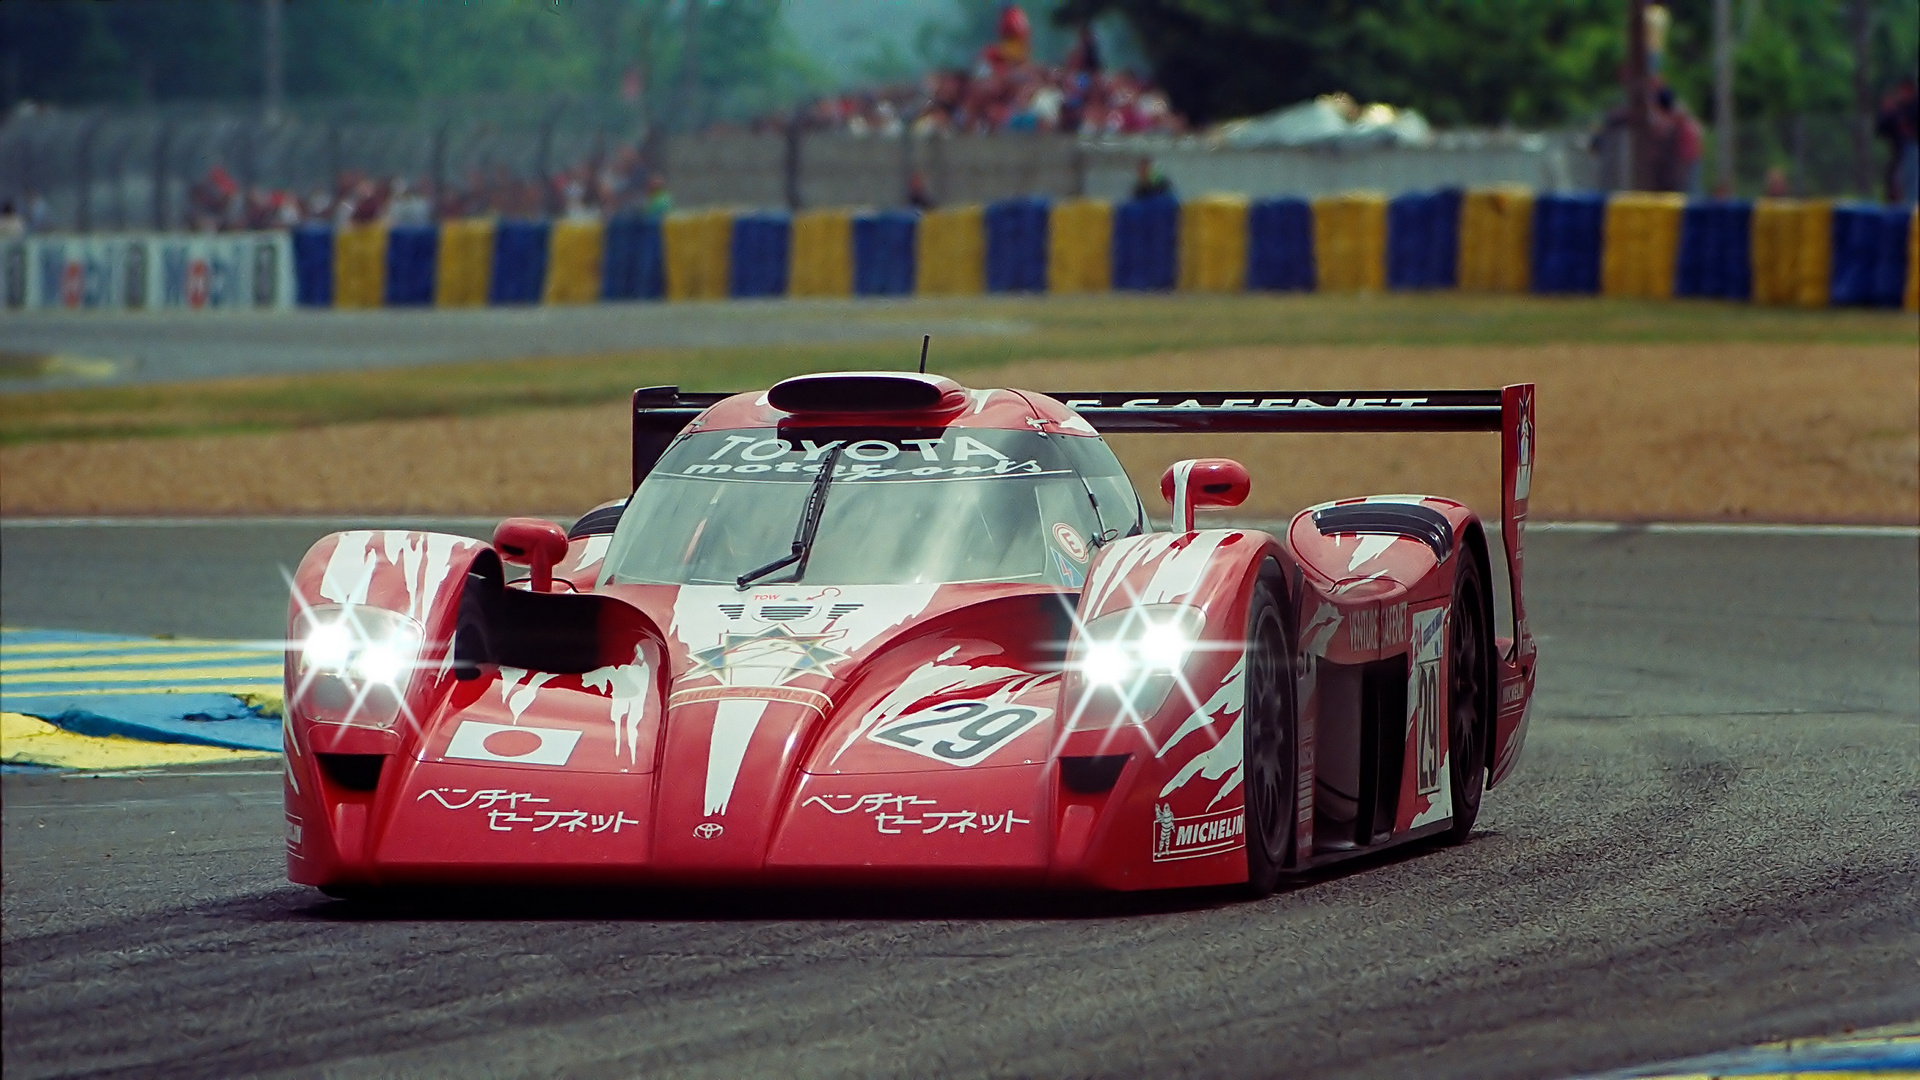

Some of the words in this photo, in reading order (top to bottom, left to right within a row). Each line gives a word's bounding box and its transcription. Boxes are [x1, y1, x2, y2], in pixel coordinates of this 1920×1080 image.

[708, 434, 1010, 462] TOYOTA
[874, 702, 1018, 760] 29
[1418, 666, 1438, 790] 29
[417, 788, 550, 809] ベンチャー
[802, 792, 937, 814] ベンチャー
[487, 809, 640, 833] セーフネット
[875, 810, 1030, 834] セーフネット
[1175, 814, 1244, 846] MICHELIN
